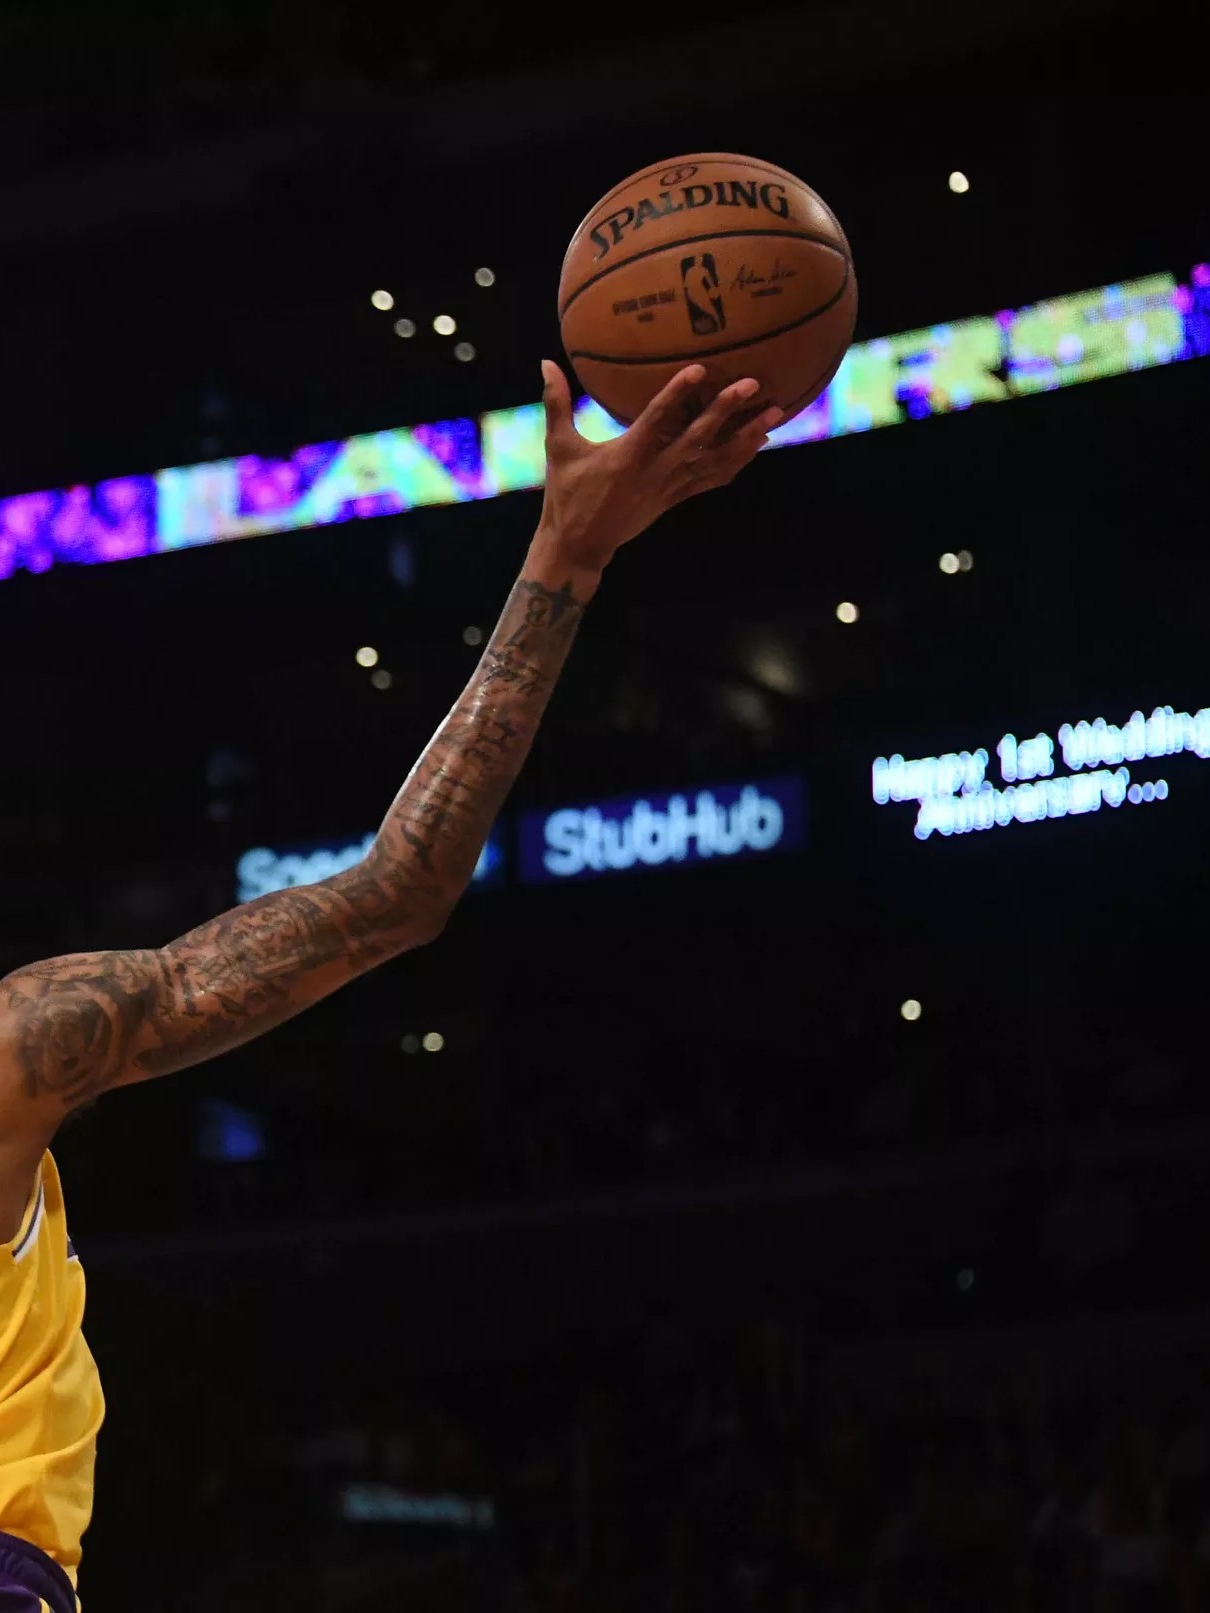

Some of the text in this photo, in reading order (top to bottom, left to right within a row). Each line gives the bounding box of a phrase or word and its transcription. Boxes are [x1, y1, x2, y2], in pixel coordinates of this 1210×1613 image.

[590, 180, 790, 262] SPALDING
[997, 732, 1054, 783] 1st
[544, 784, 783, 877] StubHub
